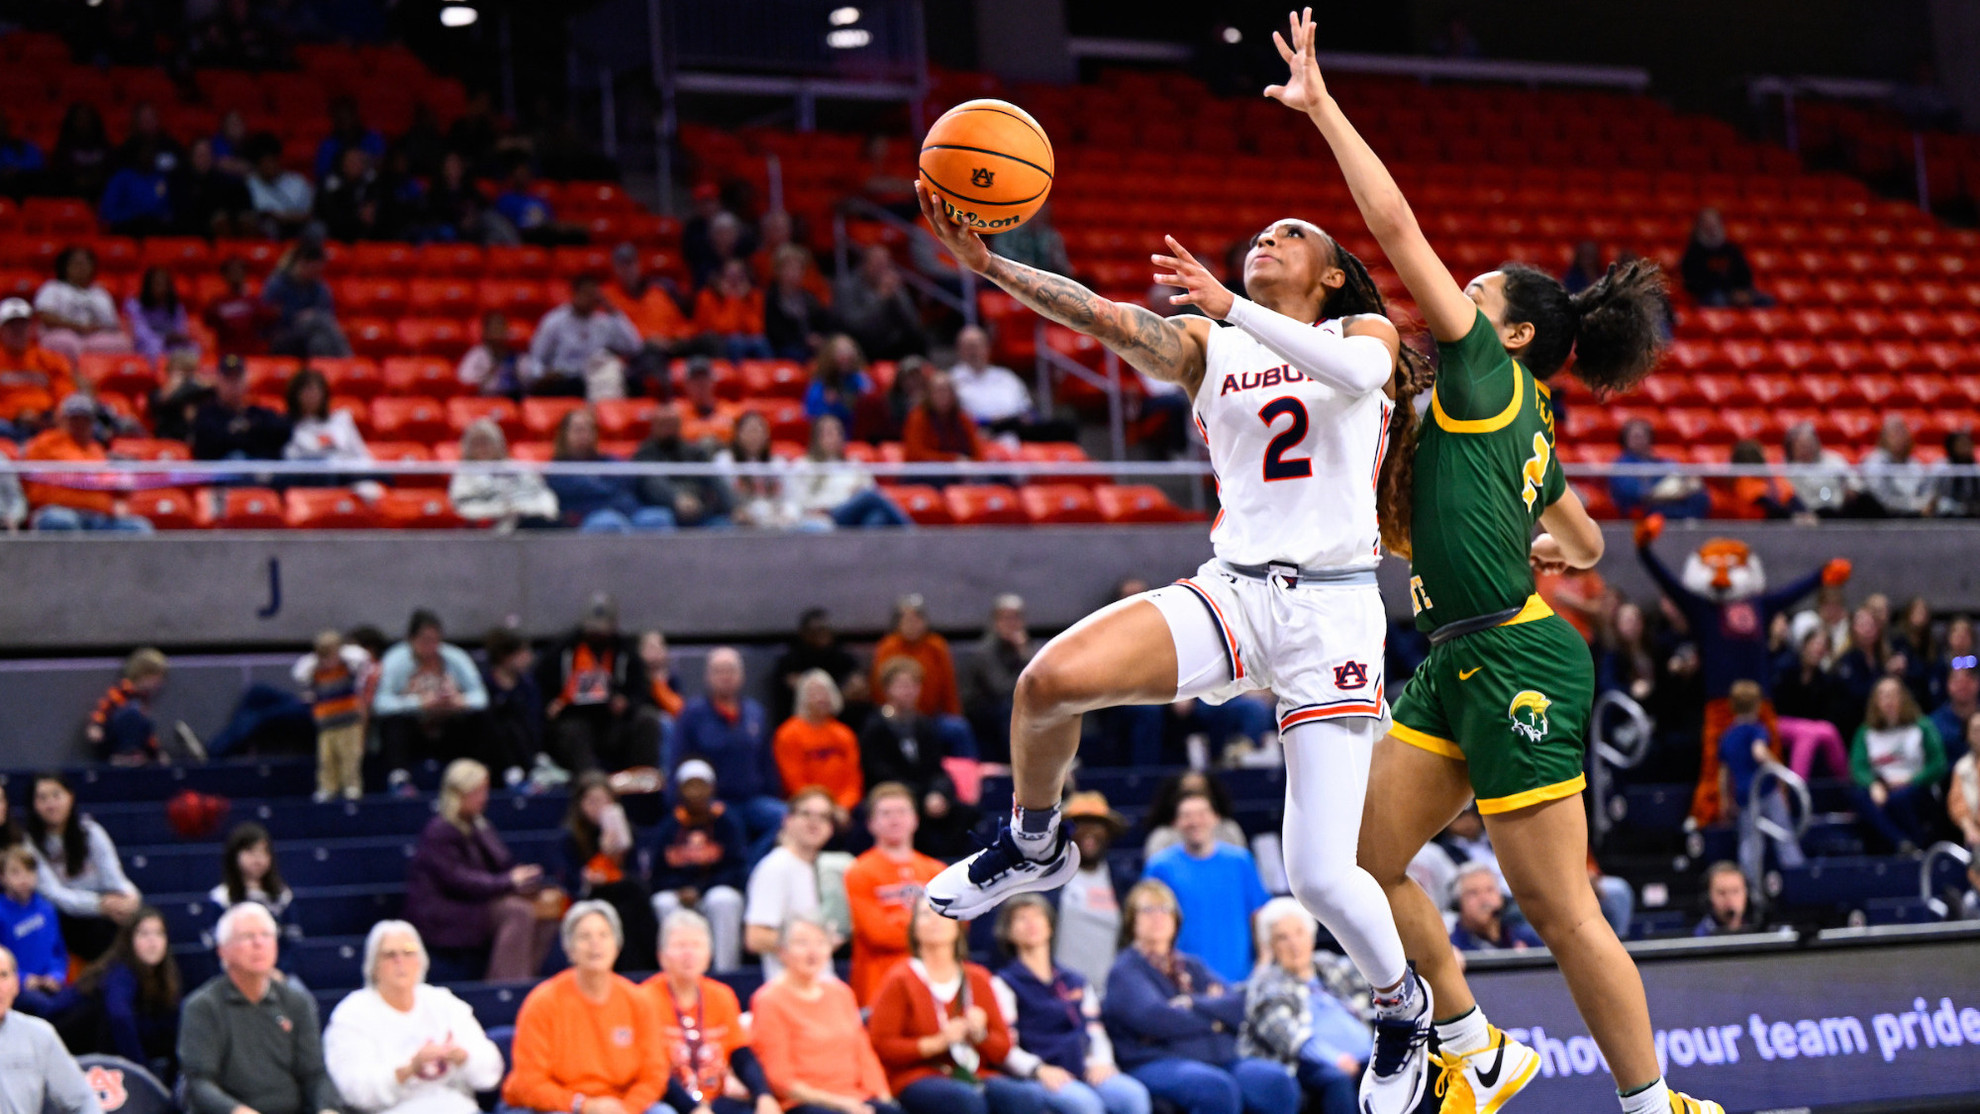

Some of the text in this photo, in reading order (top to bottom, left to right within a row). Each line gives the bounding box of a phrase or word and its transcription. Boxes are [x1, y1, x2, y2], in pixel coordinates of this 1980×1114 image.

[1220, 364, 1316, 397] AUBU
[1258, 395, 1313, 482] 2
[257, 556, 281, 619] J
[1506, 1025, 1612, 1078] ho
[1748, 1013, 1869, 1061] team
[1872, 997, 1980, 1062] pride
